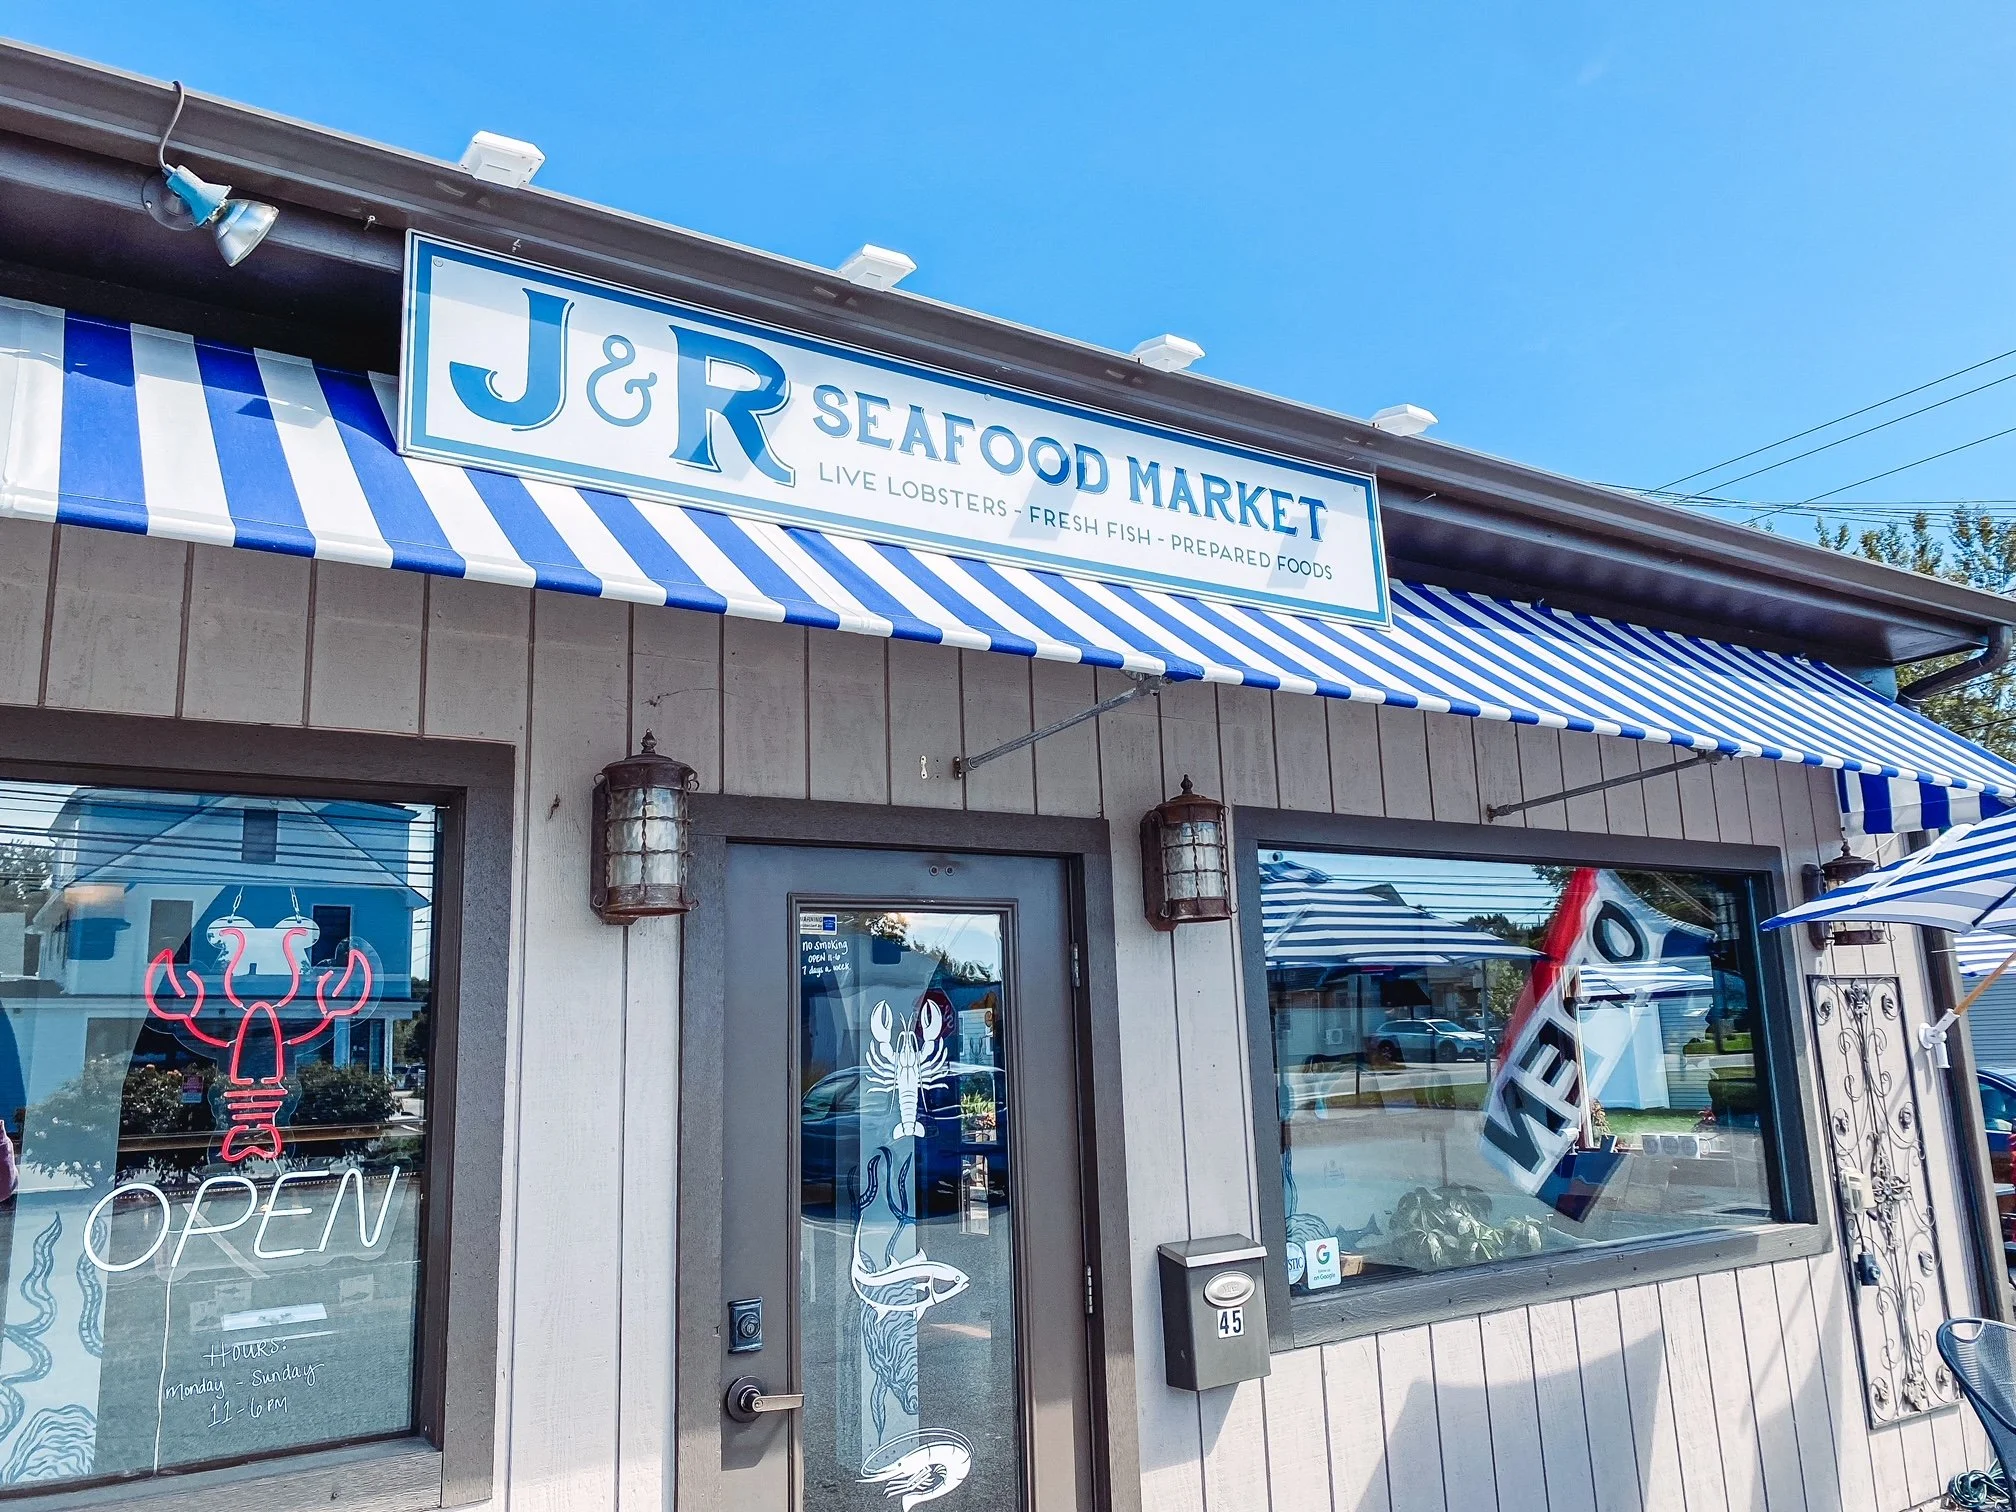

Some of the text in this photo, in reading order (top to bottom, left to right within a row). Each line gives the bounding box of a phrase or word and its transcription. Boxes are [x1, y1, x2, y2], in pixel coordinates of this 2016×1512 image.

[812, 384, 1110, 495] SEAFOOD
[1126, 454, 1328, 543] MARKET
[819, 461, 876, 493] LIVE
[887, 474, 1008, 518] LOBSTERS
[1029, 505, 1099, 536] FRESH
[1107, 522, 1152, 546] FISH
[1171, 536, 1271, 568] PREPARED
[1277, 554, 1333, 581] FOODS
[808, 952, 826, 963] OPEN
[802, 966, 807, 975] 7
[83, 1165, 400, 1272] OPEN
[1320, 1273, 1336, 1281] Google
[1219, 1310, 1242, 1335] 45
[251, 1363, 325, 1386] Sunday
